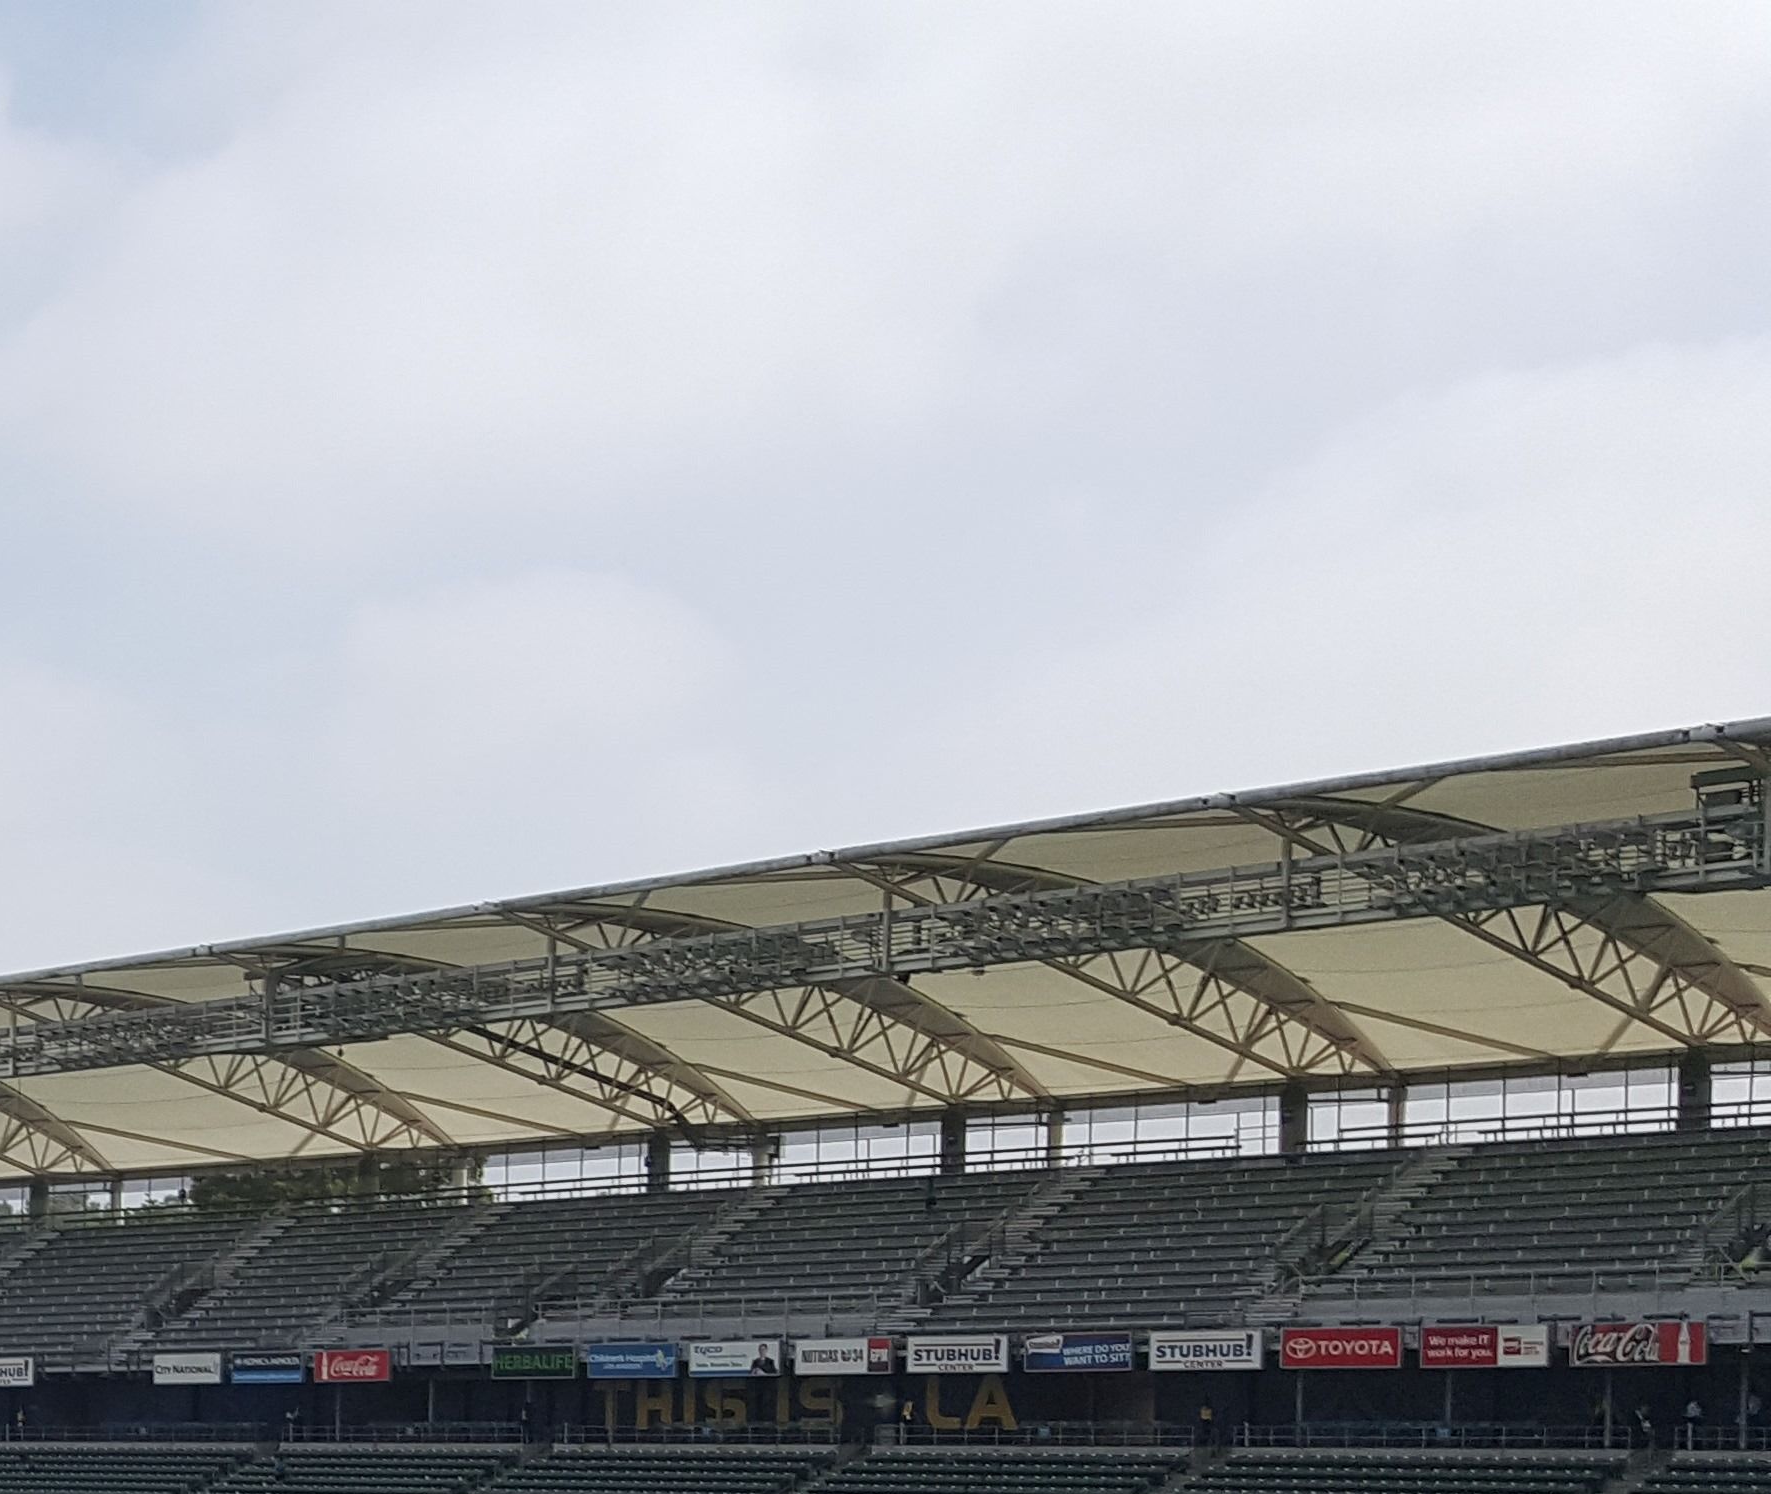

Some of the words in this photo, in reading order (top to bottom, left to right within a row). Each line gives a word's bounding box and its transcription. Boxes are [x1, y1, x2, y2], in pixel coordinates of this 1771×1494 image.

[1156, 1333, 1253, 1358] STUBHUB!
[1318, 1340, 1394, 1356] TOYOTA
[1428, 1335, 1446, 1346] We
[1447, 1335, 1477, 1346] make
[1478, 1334, 1489, 1344] IT
[913, 1338, 1001, 1361] STUBHUB!
[495, 1354, 572, 1370] HERBALIFE
[1183, 1360, 1223, 1369] CENTER
[593, 1379, 747, 1429] THIS
[776, 1379, 841, 1430] IS
[926, 1375, 1019, 1430] LA
